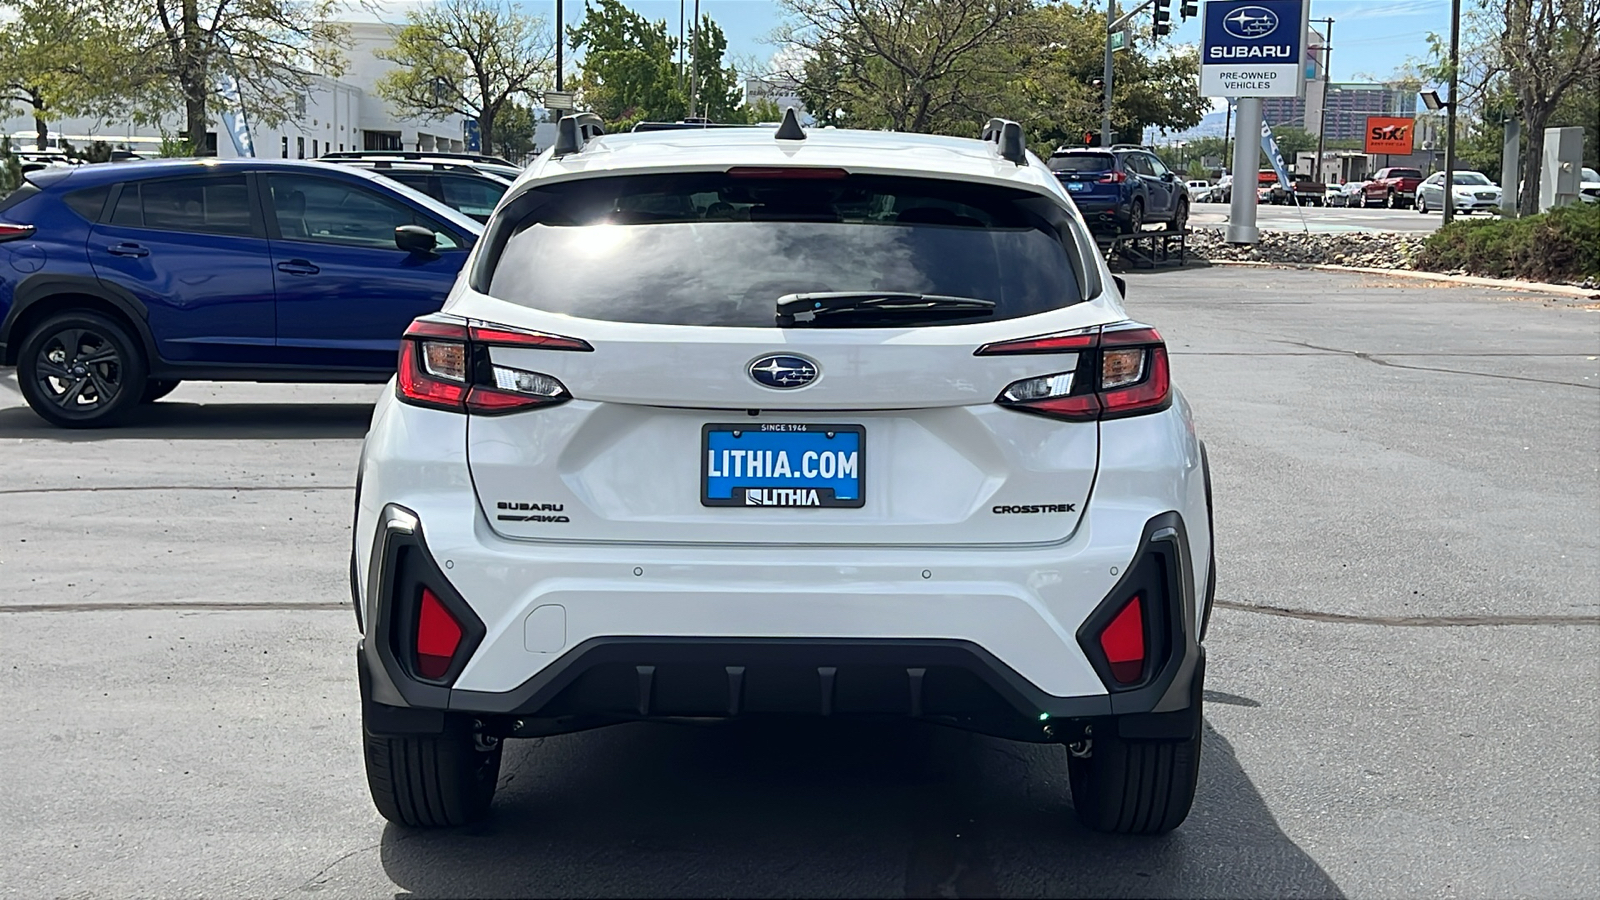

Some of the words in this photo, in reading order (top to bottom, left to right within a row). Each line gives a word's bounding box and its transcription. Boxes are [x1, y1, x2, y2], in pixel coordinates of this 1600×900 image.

[1210, 45, 1291, 58] SUBARU
[1219, 71, 1277, 80] PRE-OWNED
[1224, 81, 1271, 90] VEHICLES
[761, 424, 786, 432] SINCE
[788, 424, 807, 432] 1946
[708, 449, 858, 479] LITHIA.COM
[762, 489, 820, 506] LITHIA
[497, 501, 564, 512] SUBARU
[992, 503, 1076, 514] CROSSTREK
[524, 515, 570, 523] AWD
